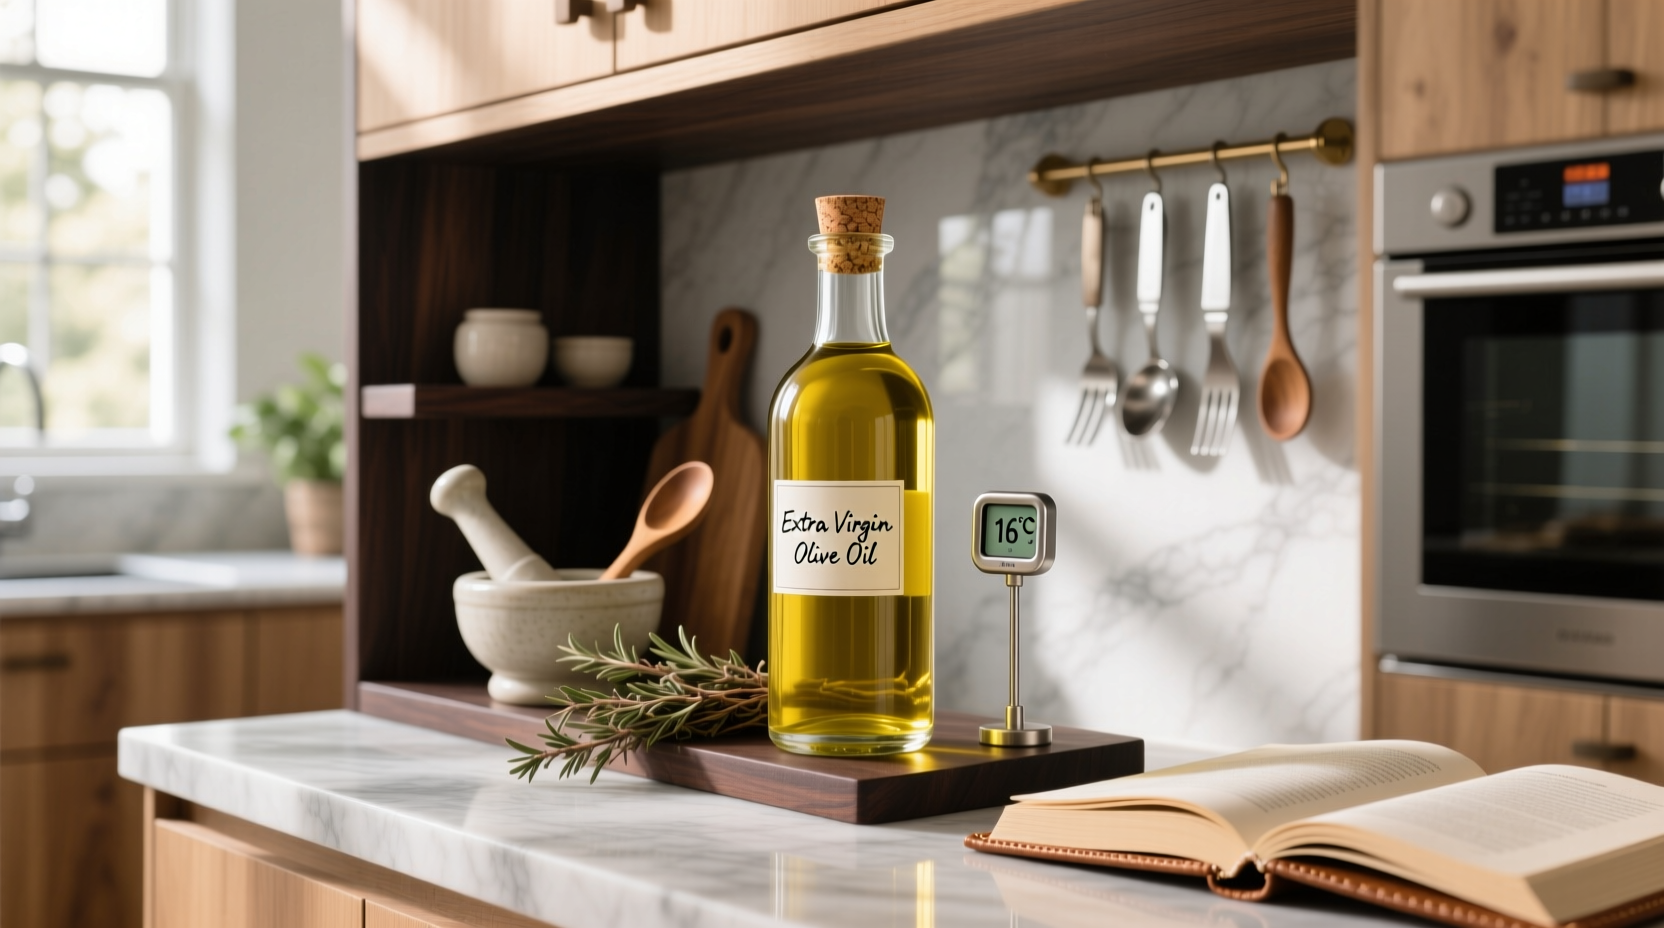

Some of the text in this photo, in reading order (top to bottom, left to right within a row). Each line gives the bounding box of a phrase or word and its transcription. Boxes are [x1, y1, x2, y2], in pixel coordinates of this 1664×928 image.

[782, 510, 893, 543] Extra Virgin
[794, 541, 878, 565] Olive Oil
